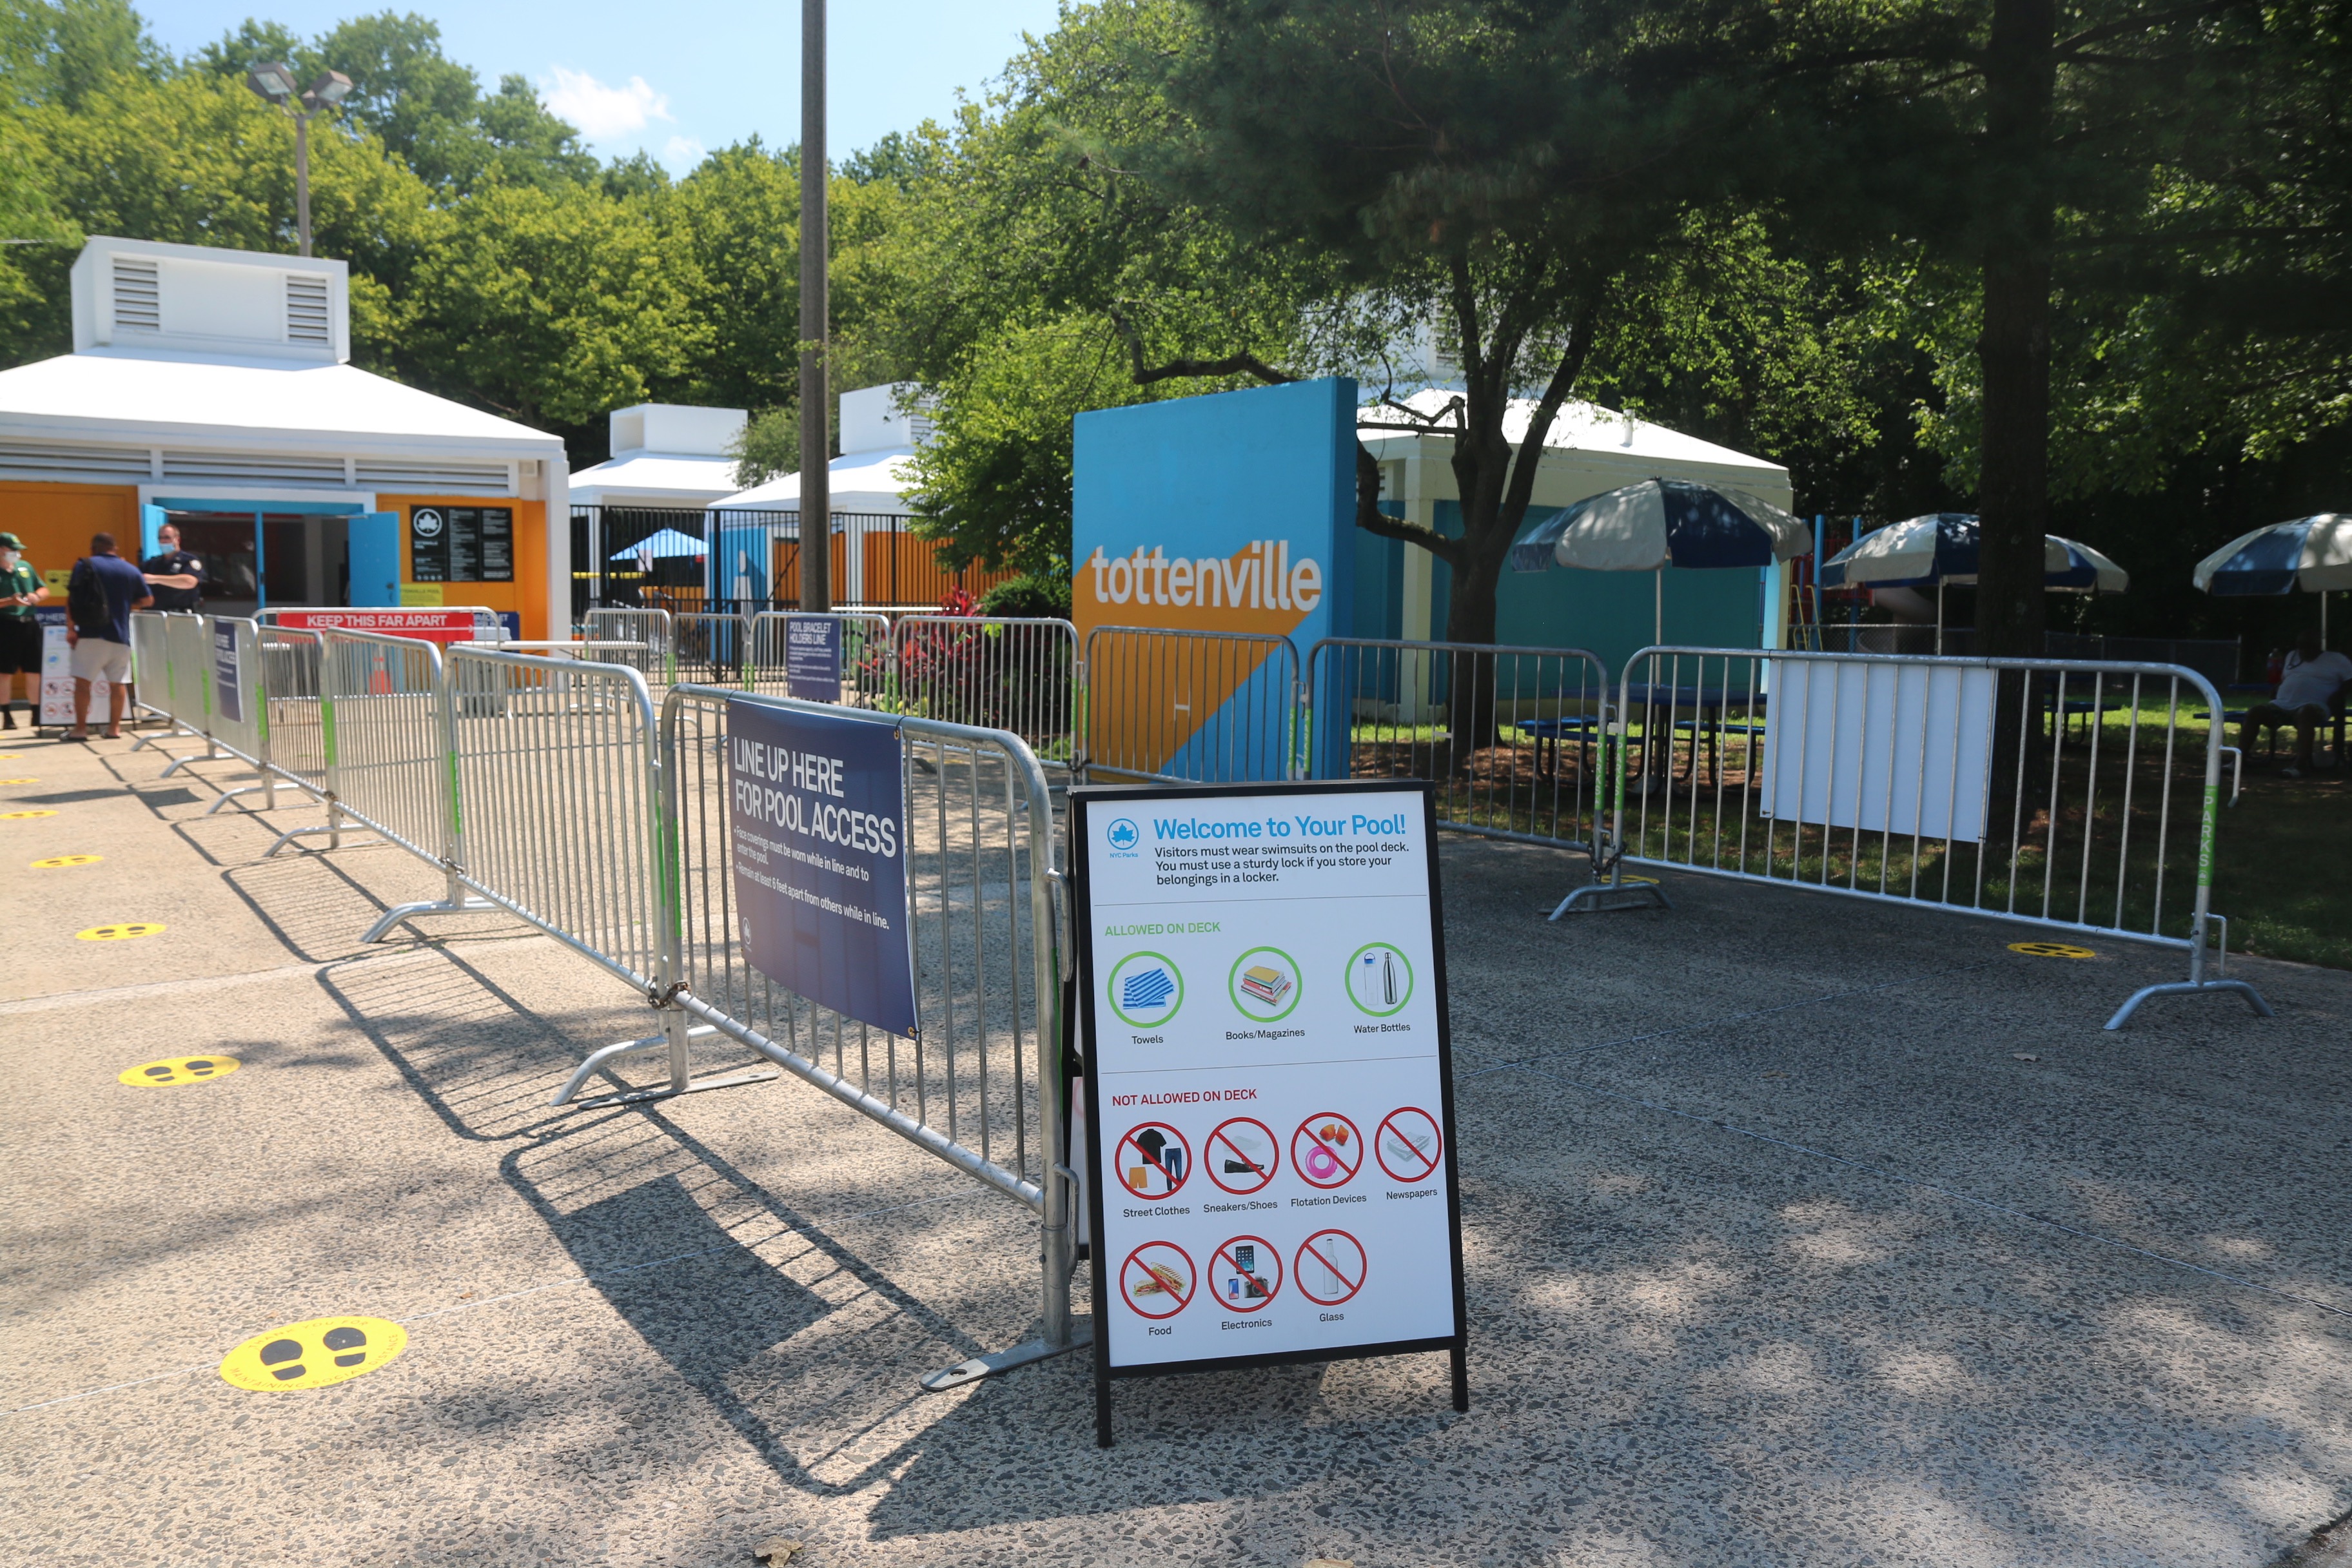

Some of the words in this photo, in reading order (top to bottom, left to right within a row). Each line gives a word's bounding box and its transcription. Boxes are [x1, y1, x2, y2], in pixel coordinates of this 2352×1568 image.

[1092, 540, 1322, 611] tottenville
[46, 613, 67, 622] HER
[307, 614, 344, 627] KEEP
[346, 614, 375, 627] THIS
[378, 614, 406, 626] FAR
[406, 614, 447, 626] APART
[789, 622, 803, 632] POOL
[803, 622, 832, 633] BRACELET
[734, 737, 764, 778] LINE
[767, 745, 789, 783] UP
[792, 750, 843, 798] HERE
[736, 779, 762, 820] FOR
[765, 788, 808, 834] POOL
[811, 801, 896, 858] ACCESS
[1153, 818, 1262, 839] Welcome
[1266, 818, 1290, 837] to
[1295, 816, 1346, 836] Your
[1352, 814, 1406, 835] Pool!
[2199, 796, 2214, 867] PARKS
[1155, 847, 1197, 857] Visitors
[1201, 847, 1230, 856] must
[1262, 844, 1317, 854] swimsuits
[1335, 843, 1353, 852] the
[1356, 842, 1378, 854] pool
[1381, 842, 1409, 852] deck.
[757, 852, 769, 865] pool.
[770, 841, 783, 854] must
[783, 844, 790, 856] be
[792, 850, 806, 862] worn
[807, 852, 824, 868] while
[825, 857, 831, 870] in
[832, 858, 845, 874] line
[846, 865, 859, 879] and
[861, 868, 869, 881] to
[1156, 861, 1176, 871] You
[1180, 861, 1208, 870] must
[1243, 858, 1279, 870] sturdy
[1282, 858, 1304, 867] lock
[1307, 857, 1314, 867] if
[1317, 859, 1335, 869] you
[1339, 857, 1366, 866] store
[1369, 858, 1391, 868] your
[1157, 874, 1217, 887] belongings
[1220, 873, 1230, 883] in
[1243, 872, 1279, 882] locker.
[754, 872, 760, 882] at
[760, 874, 772, 887] least
[772, 877, 776, 890] 6
[776, 879, 788, 895] feet
[789, 885, 804, 901] apart
[805, 890, 819, 906] from
[820, 897, 842, 914] others
[843, 904, 863, 921] while
[864, 910, 872, 924] in
[872, 912, 890, 930] line.
[1105, 924, 1164, 936] ALLOWED
[1167, 923, 1184, 934] ON
[1188, 922, 1220, 933] DECK
[1381, 1023, 1410, 1032] Bottles
[1132, 1035, 1163, 1044] Towels
[1226, 1029, 1305, 1040] Books/Magazines
[1113, 1095, 1137, 1106] NOT
[1141, 1092, 1199, 1104] ALLOWED
[1203, 1091, 1220, 1101] ON
[1224, 1089, 1257, 1100] DECK
[1291, 1197, 1330, 1207] Flotation
[1333, 1195, 1366, 1204] Devices
[1387, 1190, 1437, 1200] Newspapers
[1124, 1208, 1153, 1217] Street
[1155, 1206, 1190, 1215] Clothes
[1204, 1201, 1277, 1213] Sneakers/Shoes
[1222, 1318, 1272, 1330] Electronics
[1320, 1313, 1344, 1322] Glass
[1149, 1326, 1171, 1335] Food
[249, 1328, 294, 1350] THANK
[230, 1367, 304, 1388] MAINTAINING
[313, 1366, 366, 1384] SOCIAL
[369, 1334, 398, 1366] DISTANCE
